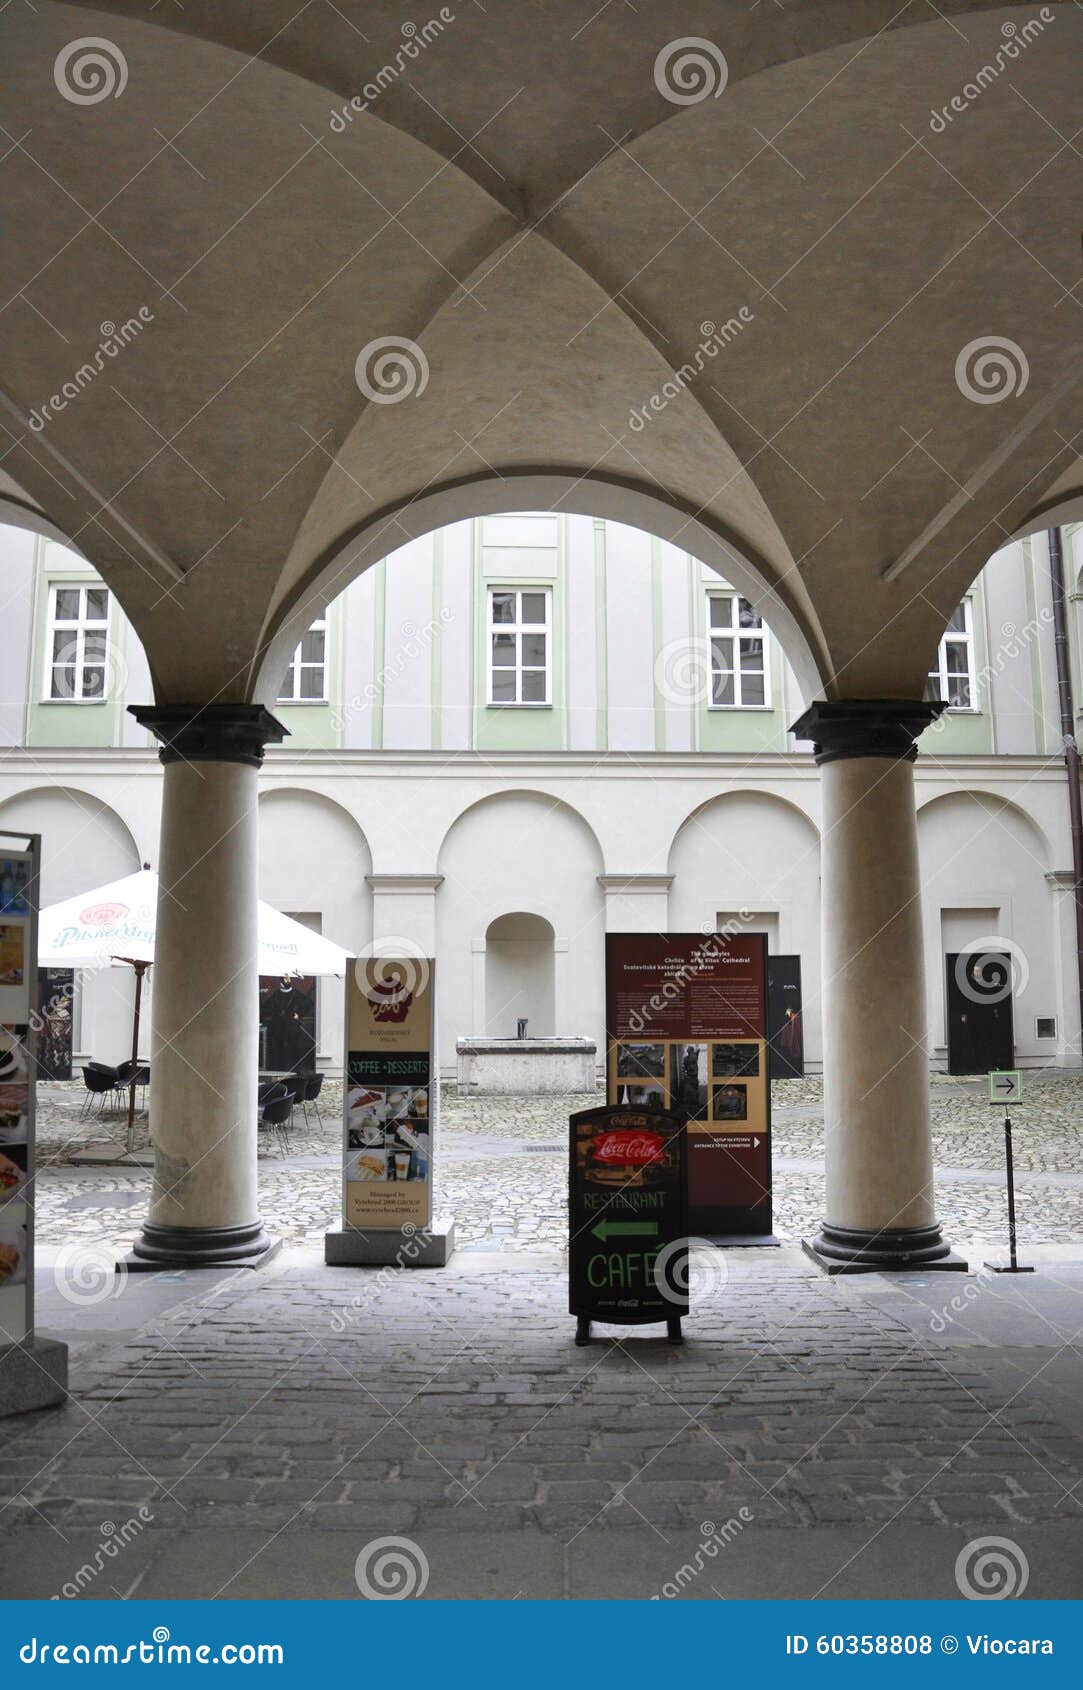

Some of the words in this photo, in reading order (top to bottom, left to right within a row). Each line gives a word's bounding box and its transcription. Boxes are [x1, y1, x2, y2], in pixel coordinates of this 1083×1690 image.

[349, 1061, 380, 1074] COFFEE
[600, 1135, 658, 1158] Coca-Cola
[583, 1191, 667, 1210] RESTAURANT
[587, 1242, 666, 1288] CAFÉ
